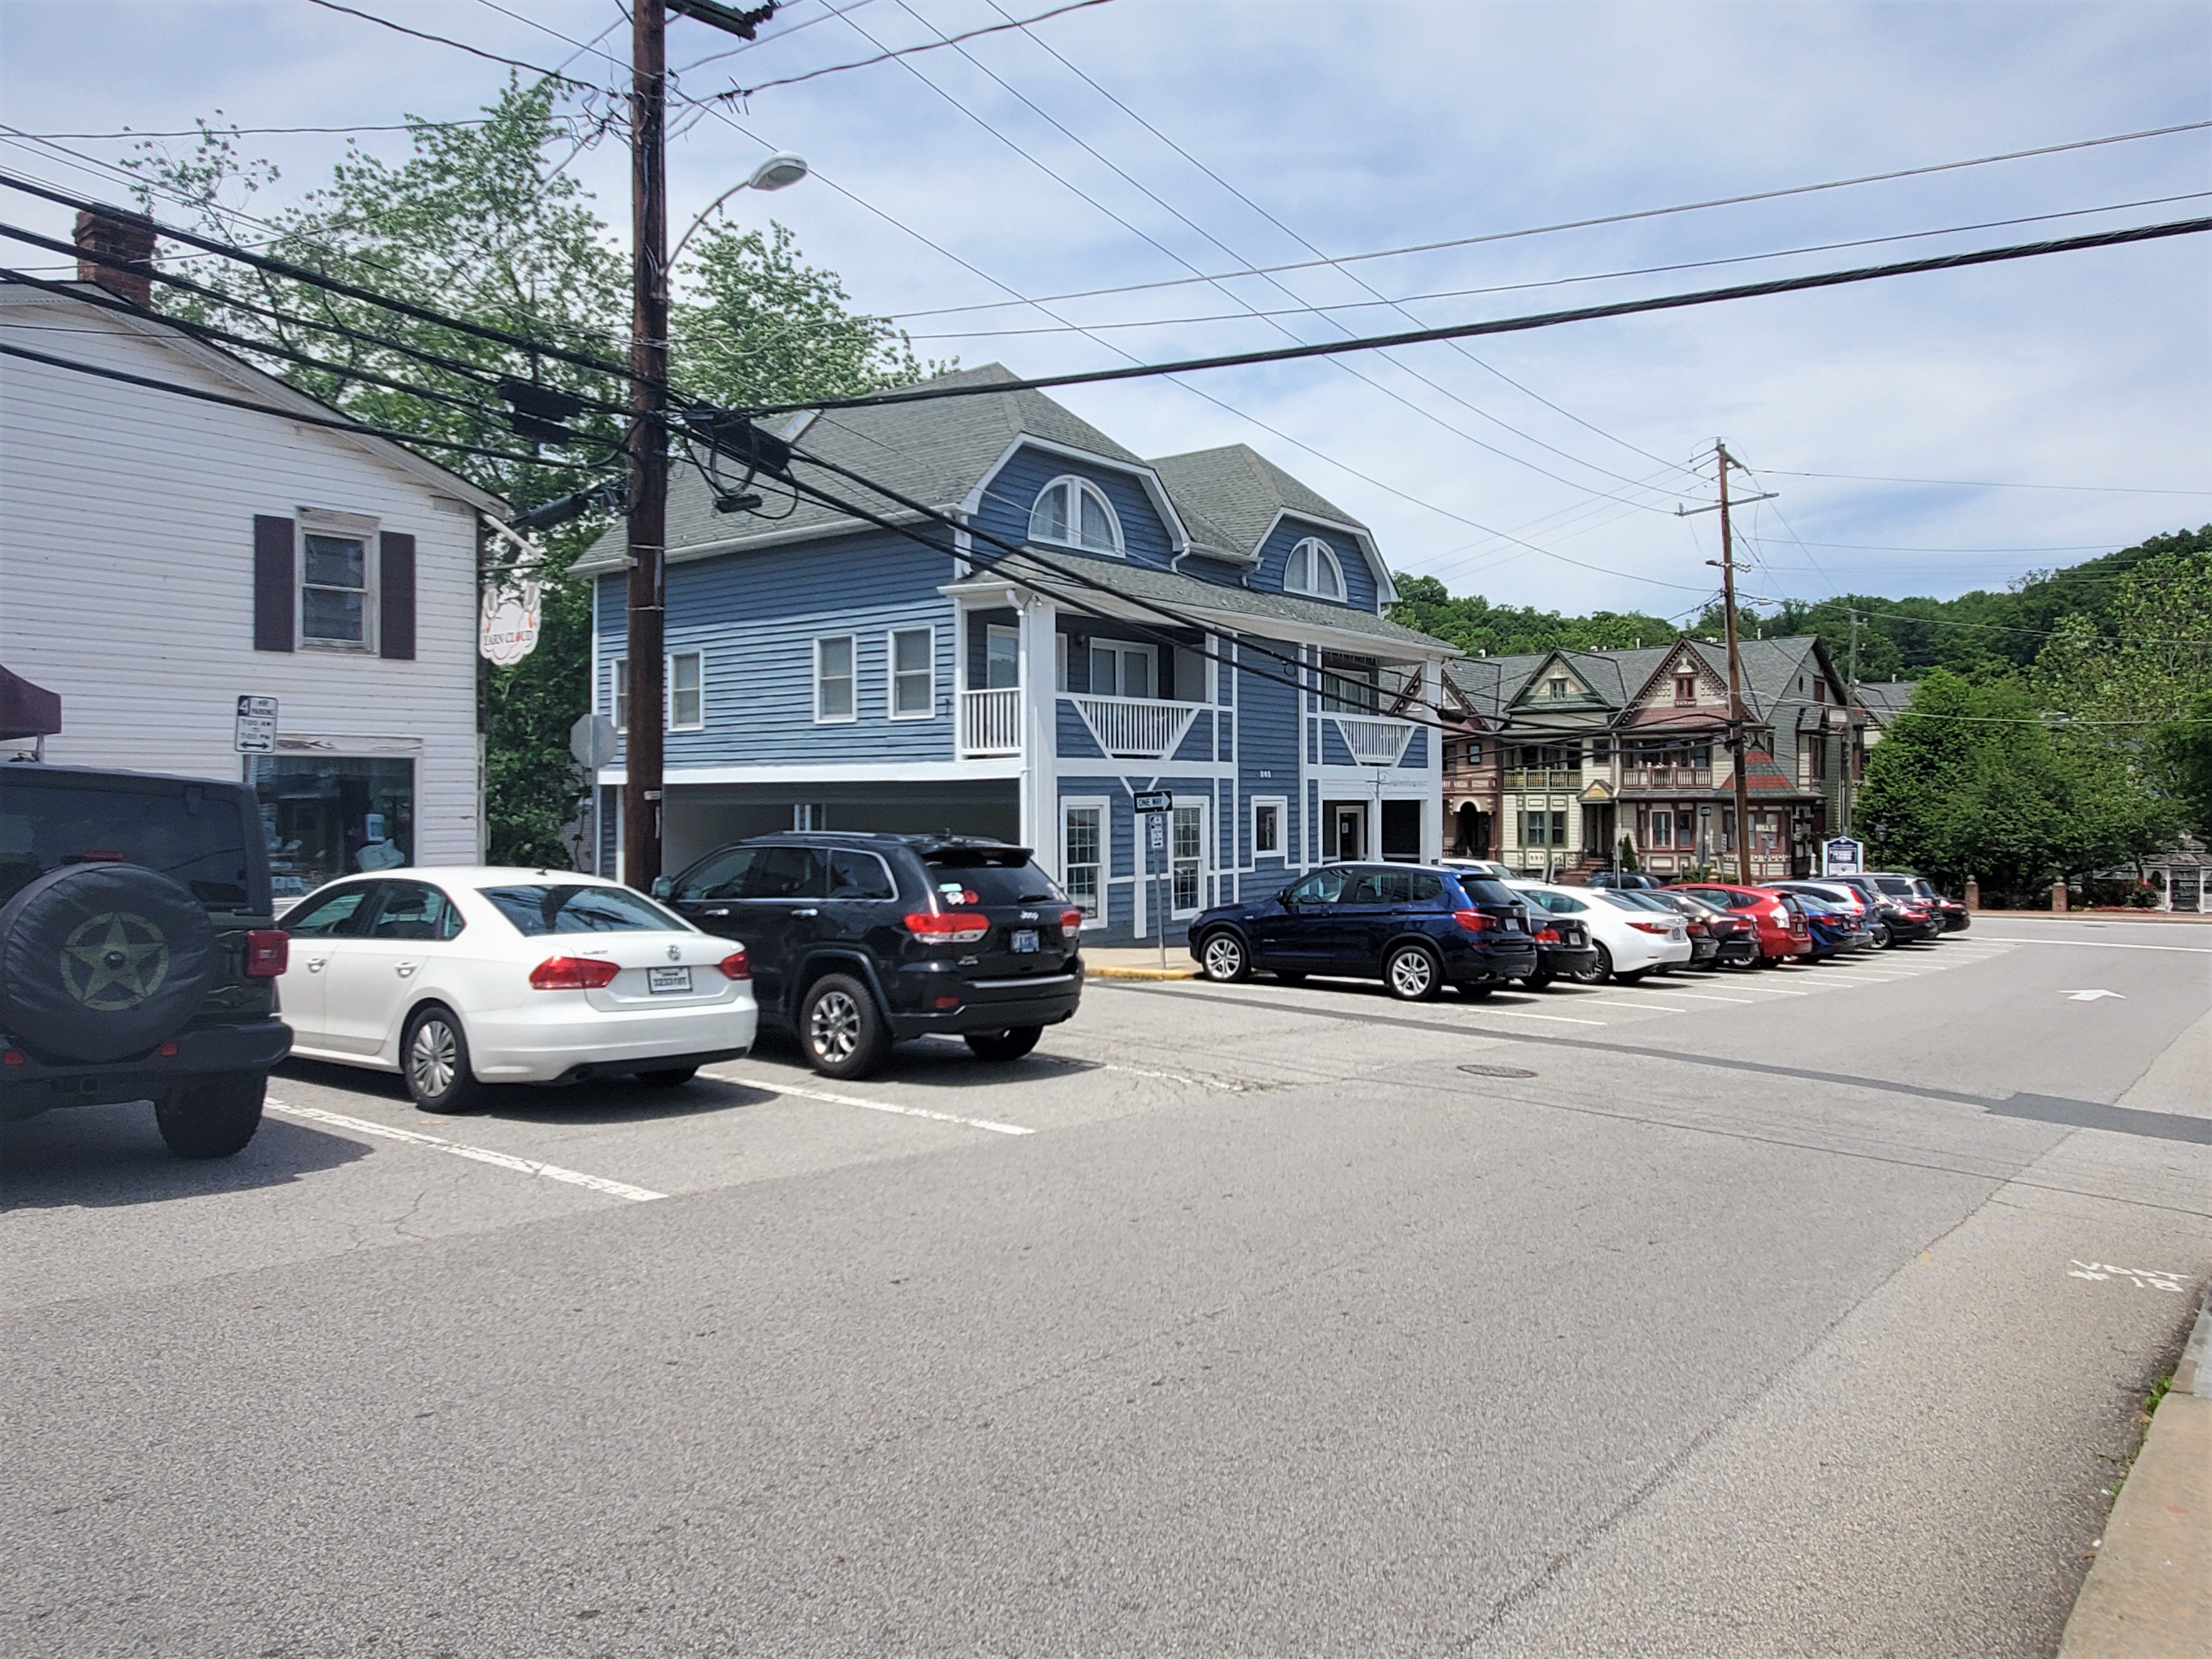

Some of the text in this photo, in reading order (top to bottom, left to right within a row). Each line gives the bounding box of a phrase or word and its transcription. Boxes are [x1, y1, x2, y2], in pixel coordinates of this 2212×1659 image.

[484, 633, 504, 646] YARN
[239, 699, 249, 714] 4
[1139, 798, 1151, 806] ONE
